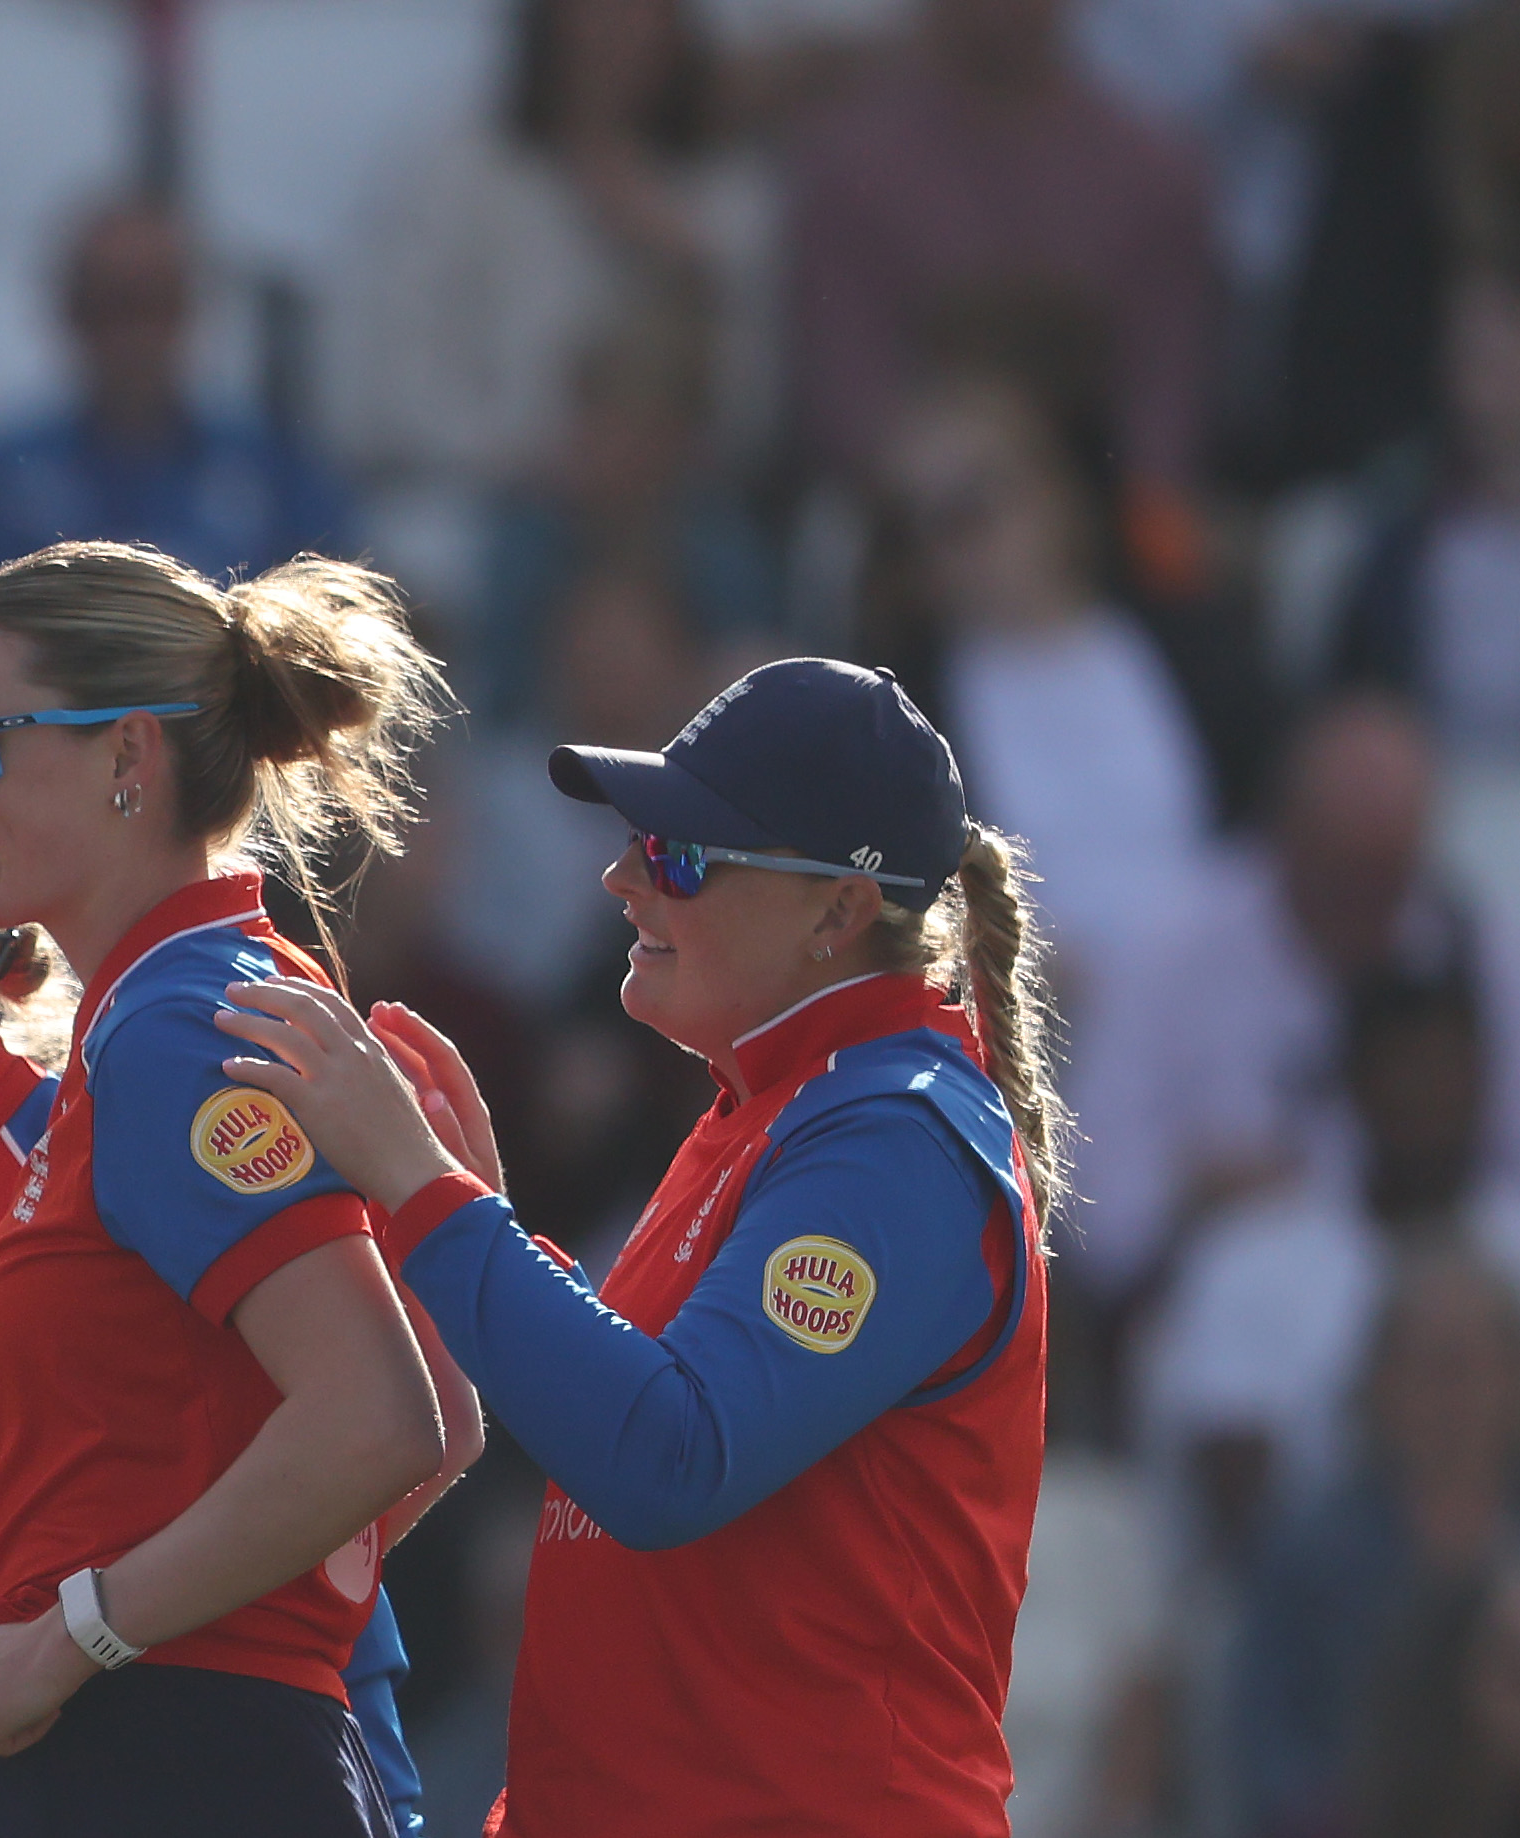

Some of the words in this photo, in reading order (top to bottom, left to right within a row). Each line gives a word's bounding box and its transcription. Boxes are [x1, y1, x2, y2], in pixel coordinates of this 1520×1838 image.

[850, 845, 883, 872] 40
[209, 1103, 271, 1156] HULA
[227, 1125, 301, 1185] HOOPS
[783, 1256, 855, 1298] HULA
[772, 1287, 855, 1335] HOOPS
